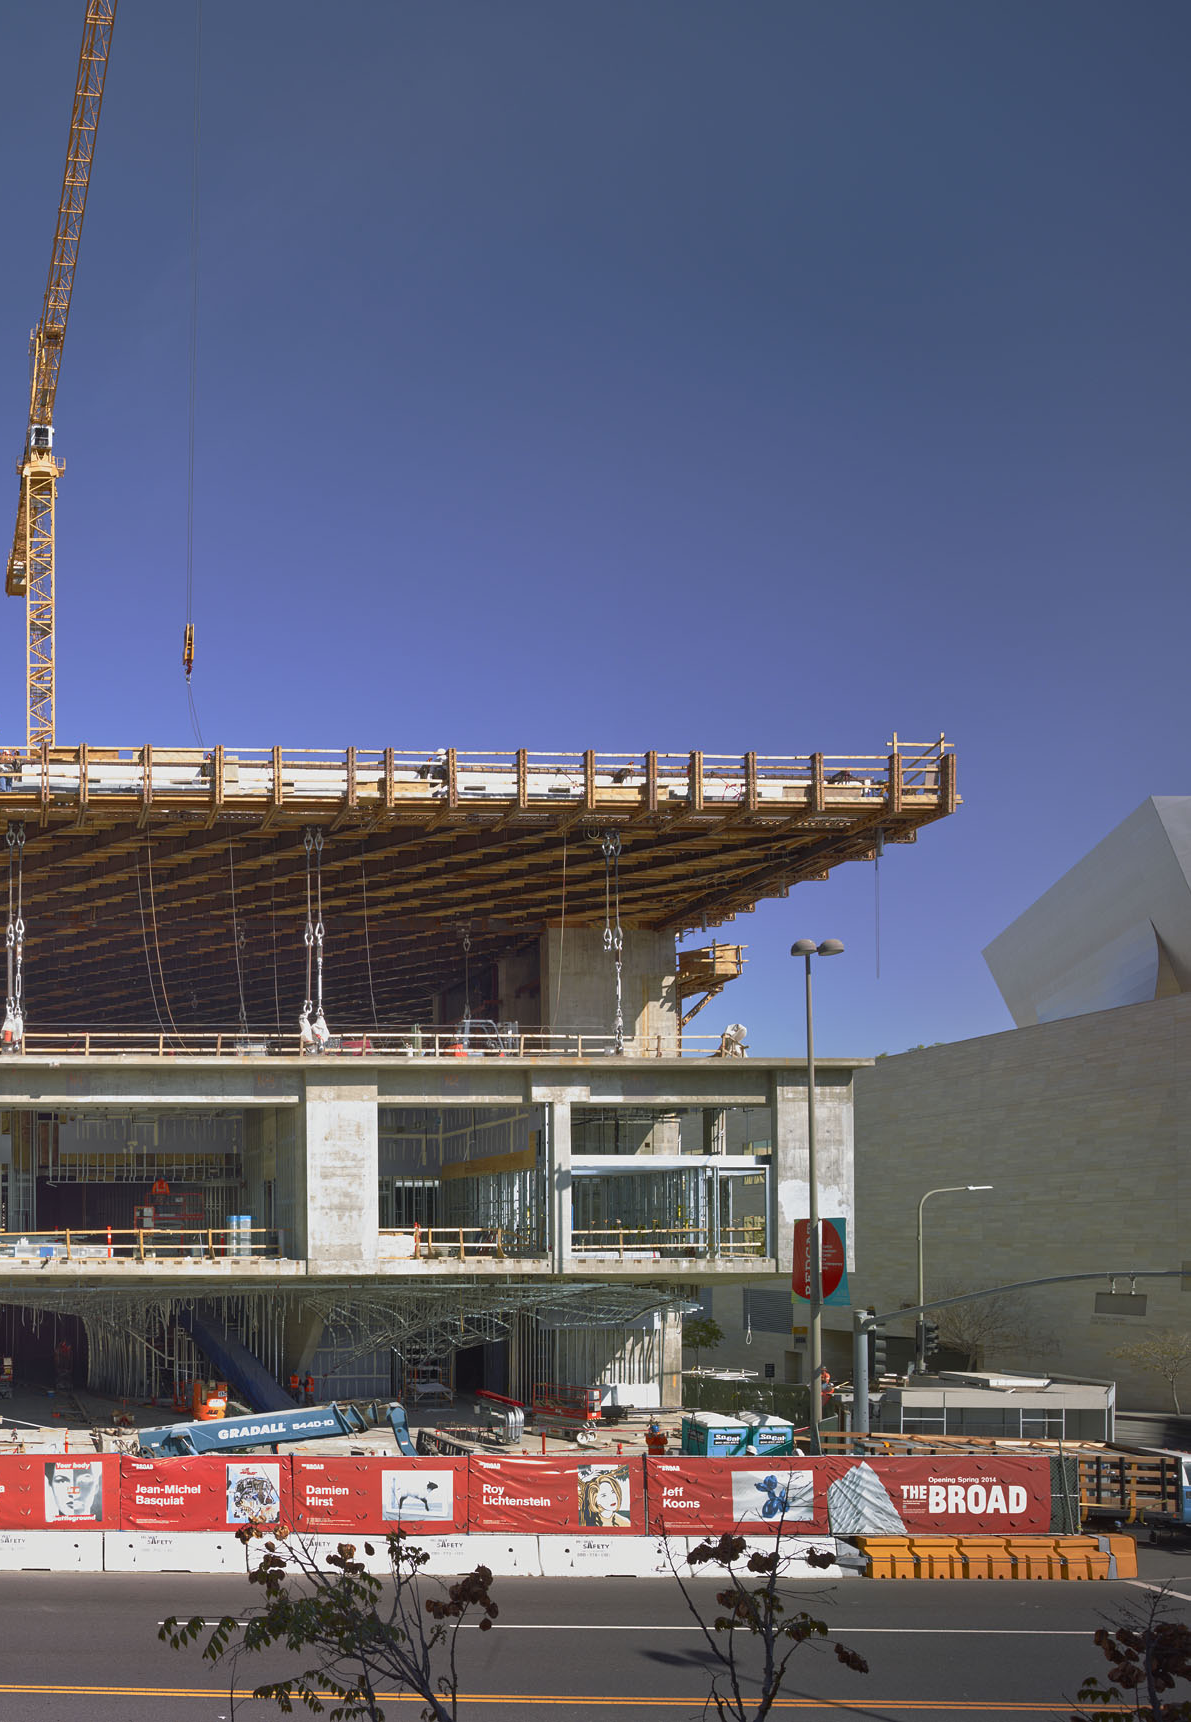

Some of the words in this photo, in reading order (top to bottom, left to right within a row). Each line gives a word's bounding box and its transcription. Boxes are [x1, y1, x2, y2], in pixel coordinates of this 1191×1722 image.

[218, 1422, 286, 1440] GRADALL
[928, 1476, 956, 1484] Opening
[957, 1476, 979, 1484] Spring
[136, 1484, 201, 1494] Jean-Michel
[306, 1485, 349, 1495] Damien
[483, 1484, 504, 1496] Roy
[662, 1487, 684, 1497] Jeff
[136, 1496, 184, 1507] Basquiat
[306, 1497, 334, 1507] Hirst
[483, 1496, 551, 1507] Lichtenstein
[663, 1499, 700, 1509] Koons
[900, 1485, 927, 1500] THE
[928, 1484, 1028, 1514] BROAD
